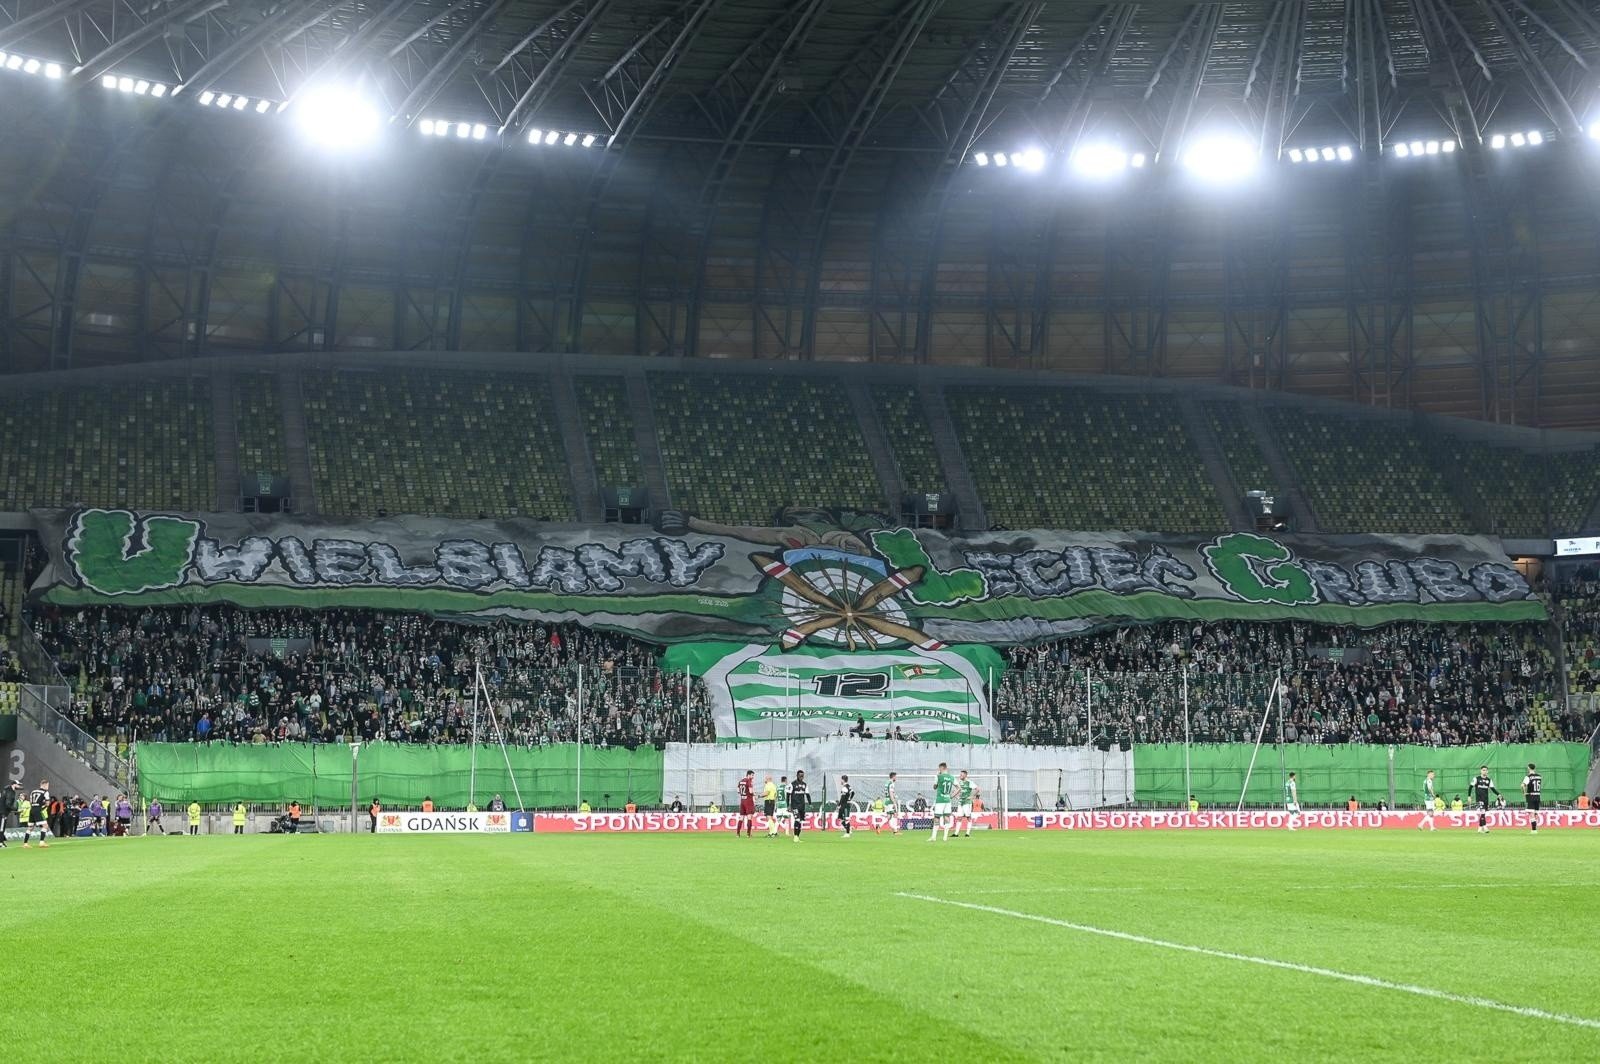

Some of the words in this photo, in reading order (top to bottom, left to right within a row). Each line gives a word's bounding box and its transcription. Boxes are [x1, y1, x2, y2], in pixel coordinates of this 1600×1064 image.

[1198, 531, 1531, 607] GRUBO
[812, 672, 889, 698] 12
[760, 709, 857, 719] DWUNASTY
[873, 709, 962, 721] ZAWODNIK
[9, 749, 25, 780] 3
[942, 781, 952, 794] 11
[1532, 780, 1540, 791] 16
[407, 814, 479, 831] GDAŃSK
[573, 814, 701, 831] SPONSOR
[1026, 812, 1143, 829] SPONSOR
[1150, 812, 1284, 828] POLSKIEGO
[1286, 812, 1383, 828] SPORTU
